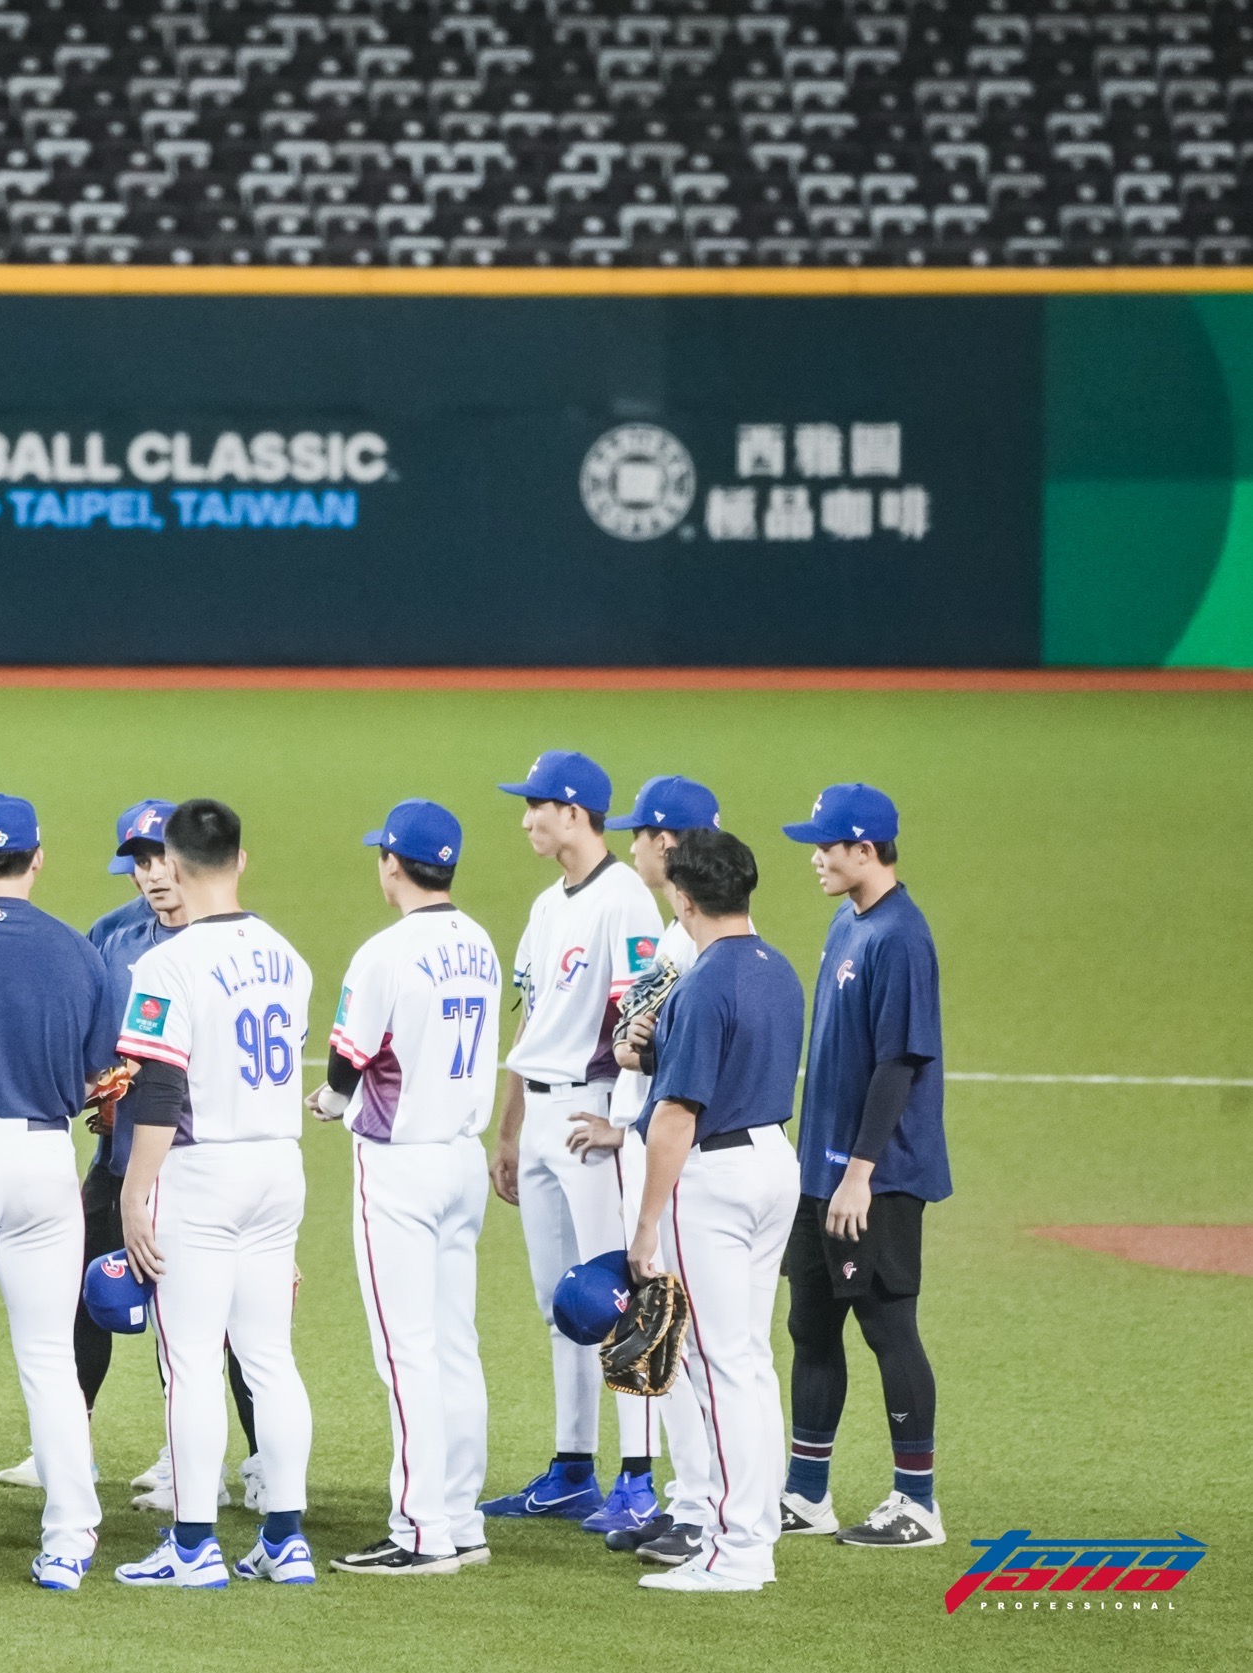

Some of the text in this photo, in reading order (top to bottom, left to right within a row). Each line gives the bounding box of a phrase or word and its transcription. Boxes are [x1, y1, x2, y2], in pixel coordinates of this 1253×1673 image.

[126, 430, 390, 485] CLASSIC
[170, 489, 360, 529] TAIWAN
[234, 1002, 294, 1090] 96
[442, 996, 487, 1079] 77
